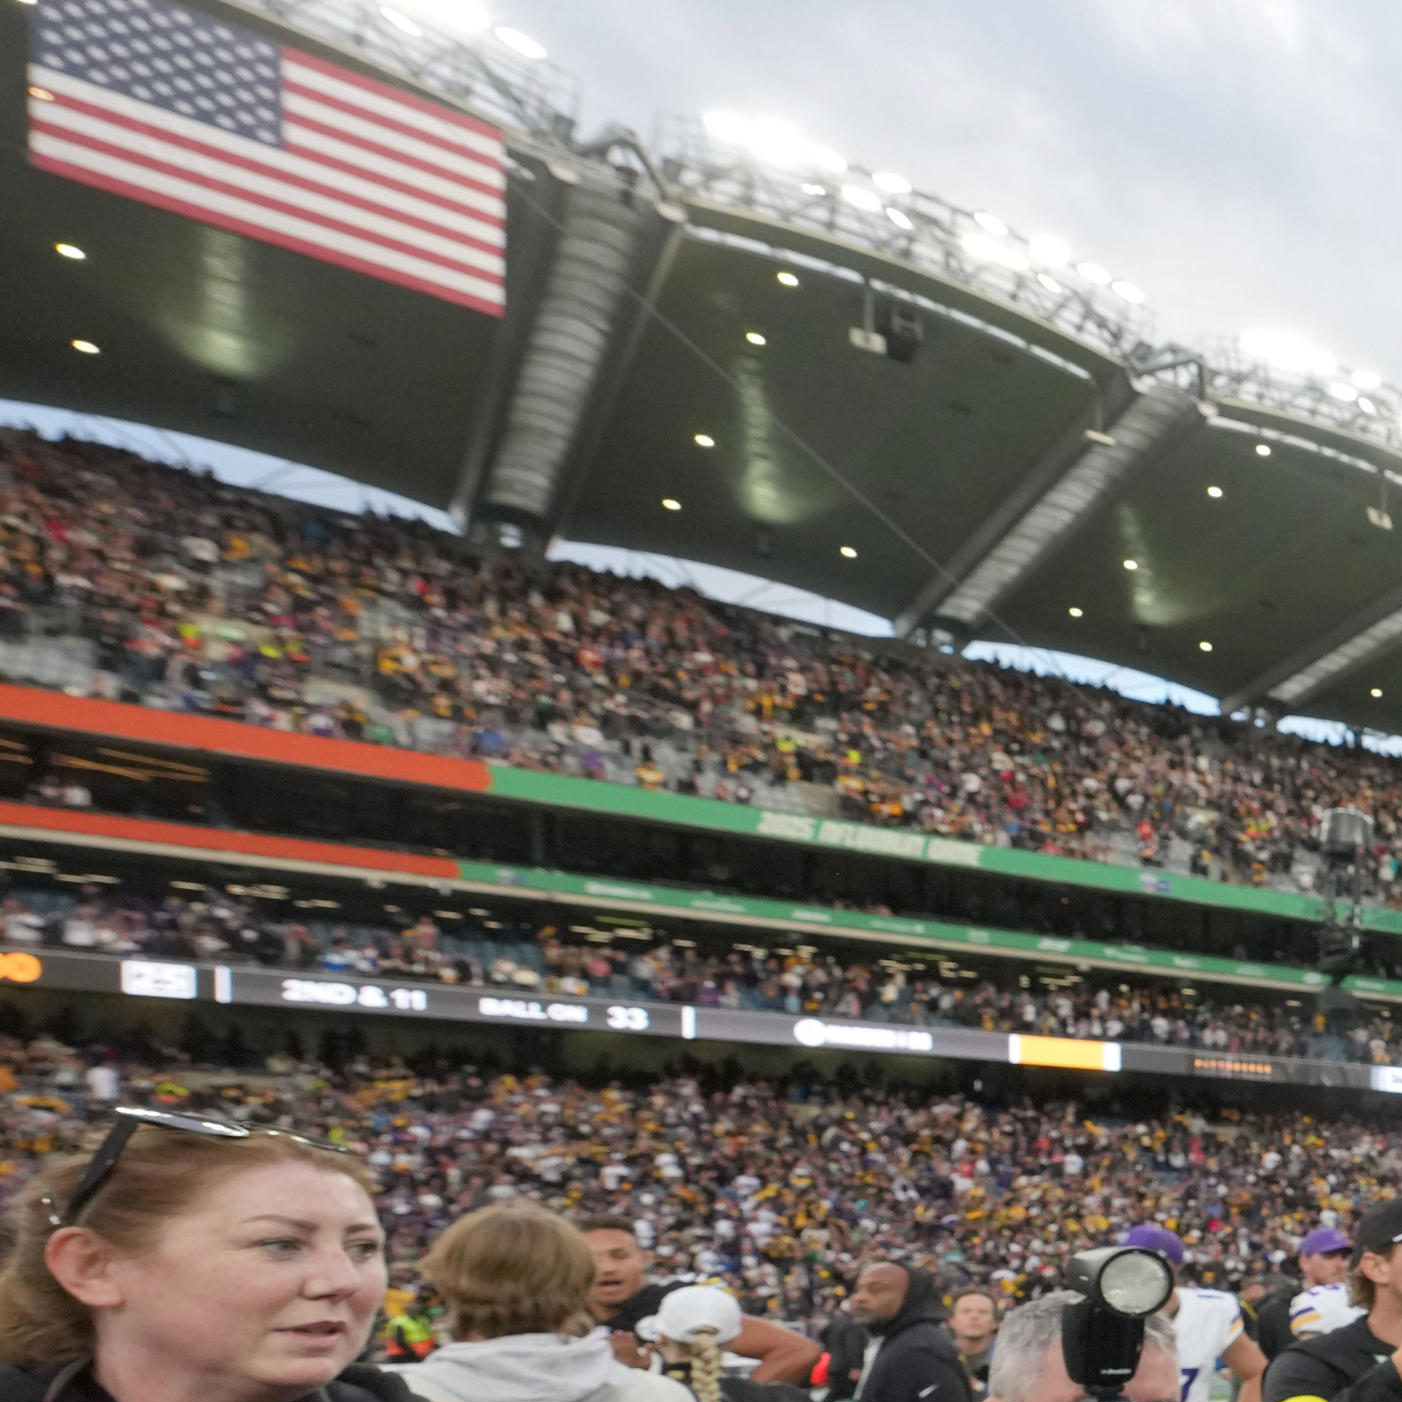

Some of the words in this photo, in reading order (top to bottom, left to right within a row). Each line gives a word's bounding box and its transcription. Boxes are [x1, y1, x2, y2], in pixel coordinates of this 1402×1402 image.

[281, 979, 357, 1005] 2ND
[357, 985, 389, 1008] &
[389, 987, 428, 1011] 11
[546, 1002, 589, 1024] ON
[606, 1005, 650, 1031] 33
